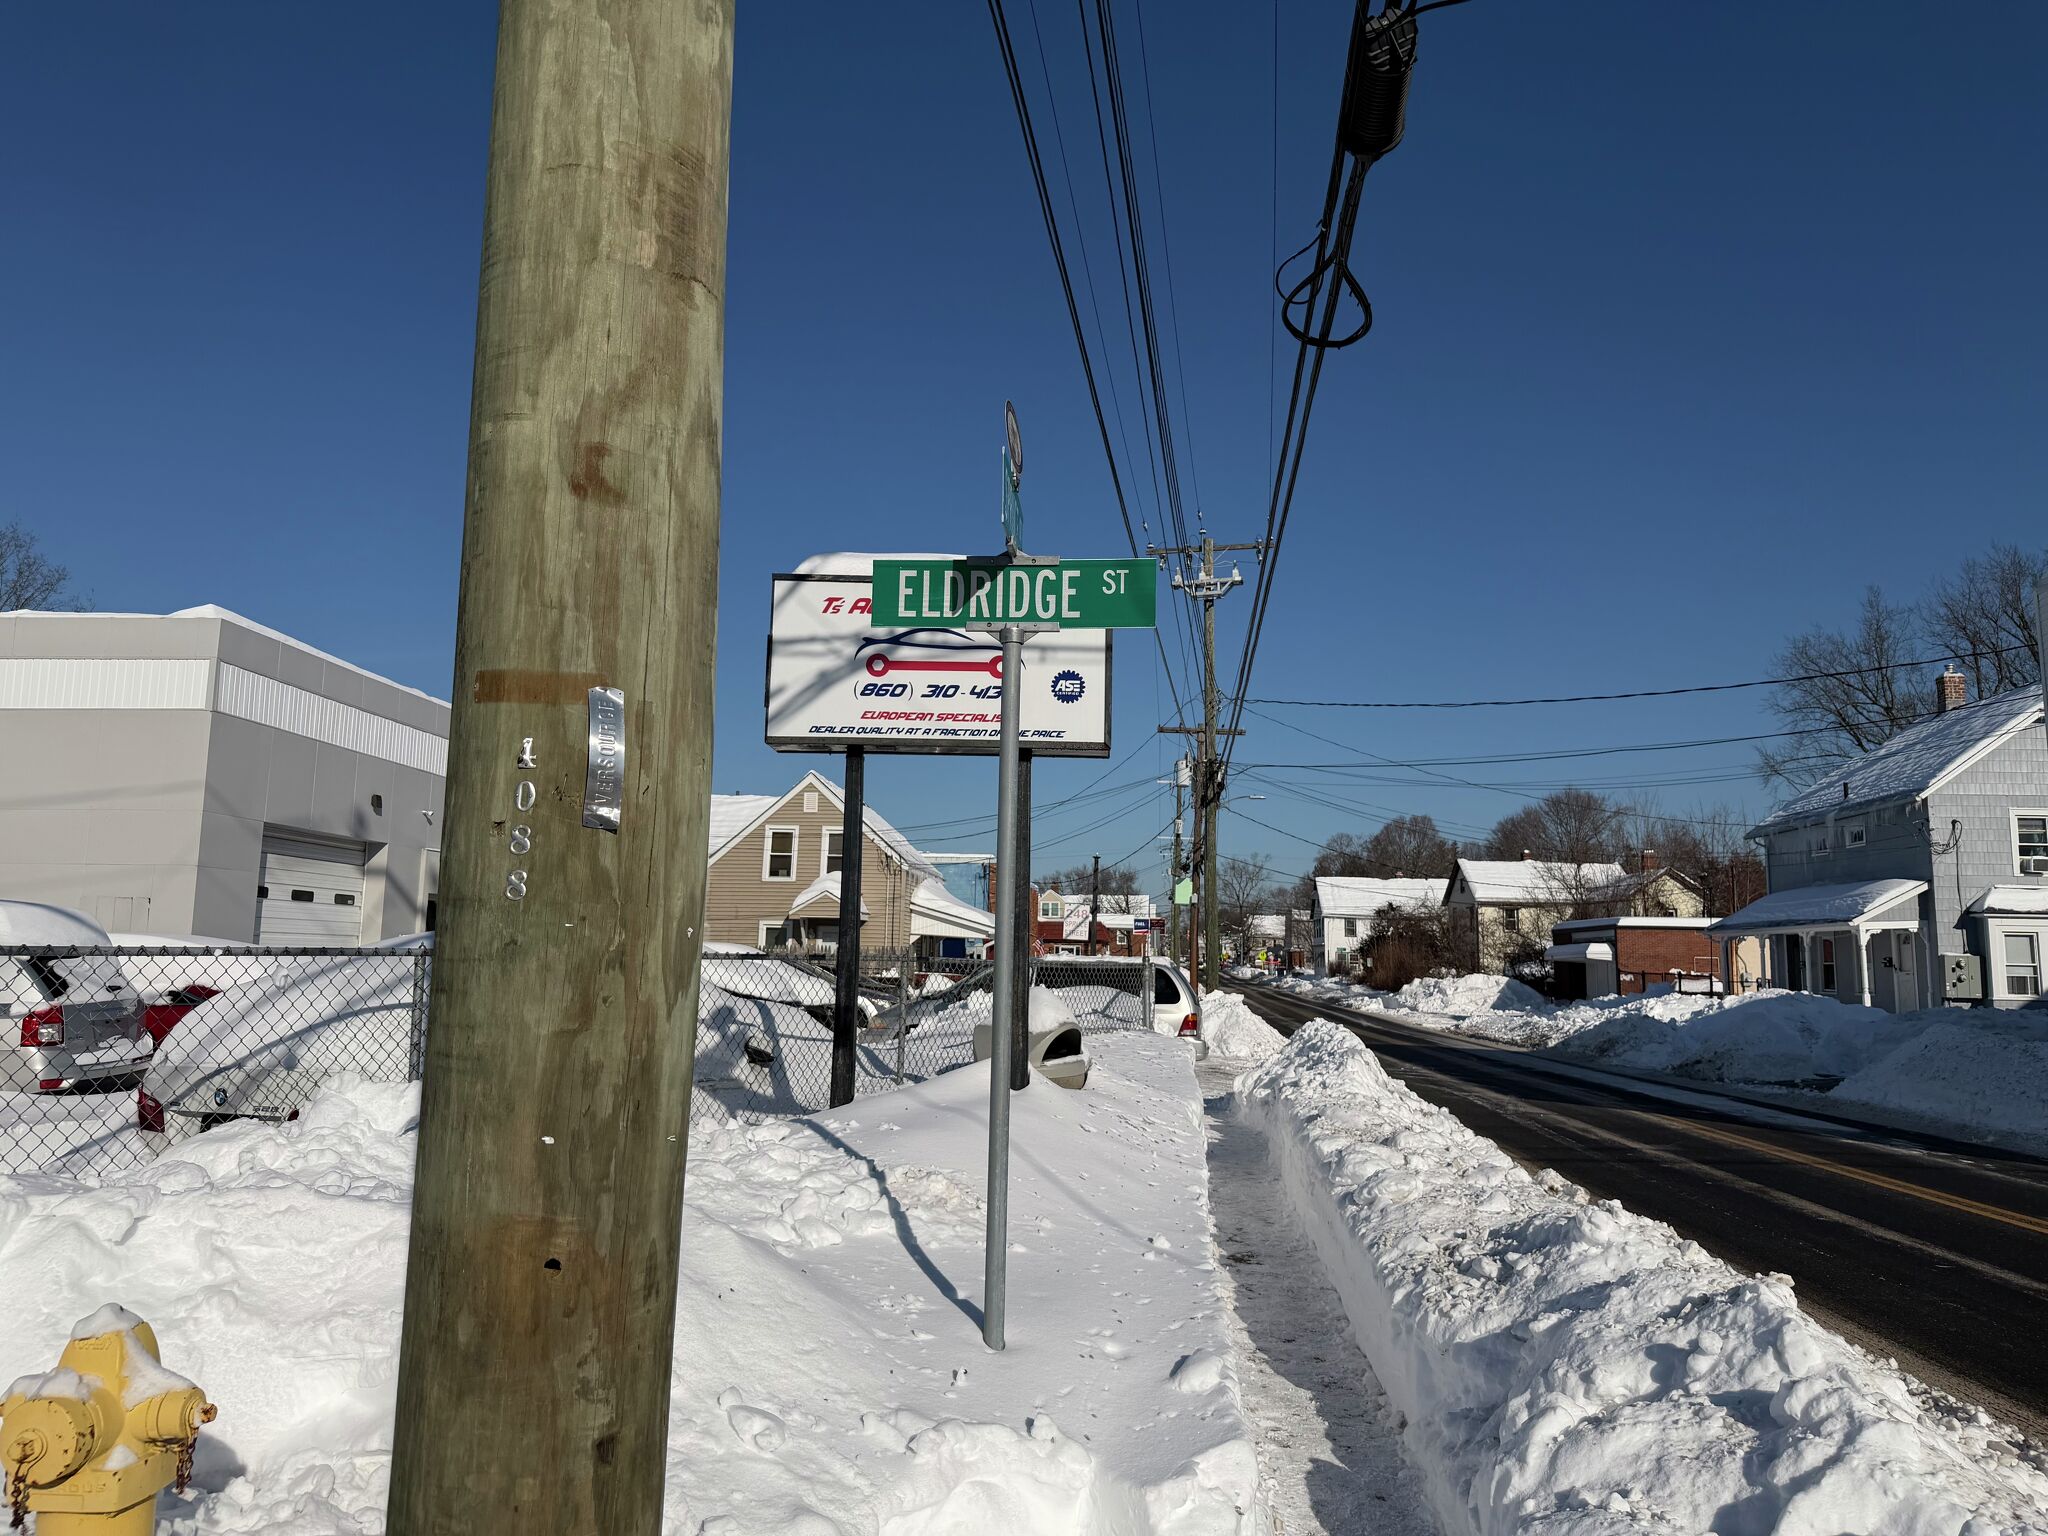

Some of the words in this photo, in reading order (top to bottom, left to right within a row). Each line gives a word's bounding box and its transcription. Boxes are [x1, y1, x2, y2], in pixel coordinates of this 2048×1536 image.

[898, 570, 1081, 619] ELDRIDGE
[1102, 569, 1129, 594] ST
[854, 680, 913, 700] (860)
[1055, 680, 1080, 691] ASE
[861, 711, 934, 721] EUROPEAN
[935, 713, 1001, 722] SPECIALIS
[809, 725, 855, 734] DEALER
[856, 726, 904, 734] QUALITY
[905, 727, 921, 735] AT
[932, 728, 989, 736] FRACTION
[1031, 730, 1067, 738] PRICE
[1066, 908, 1088, 919] 248
